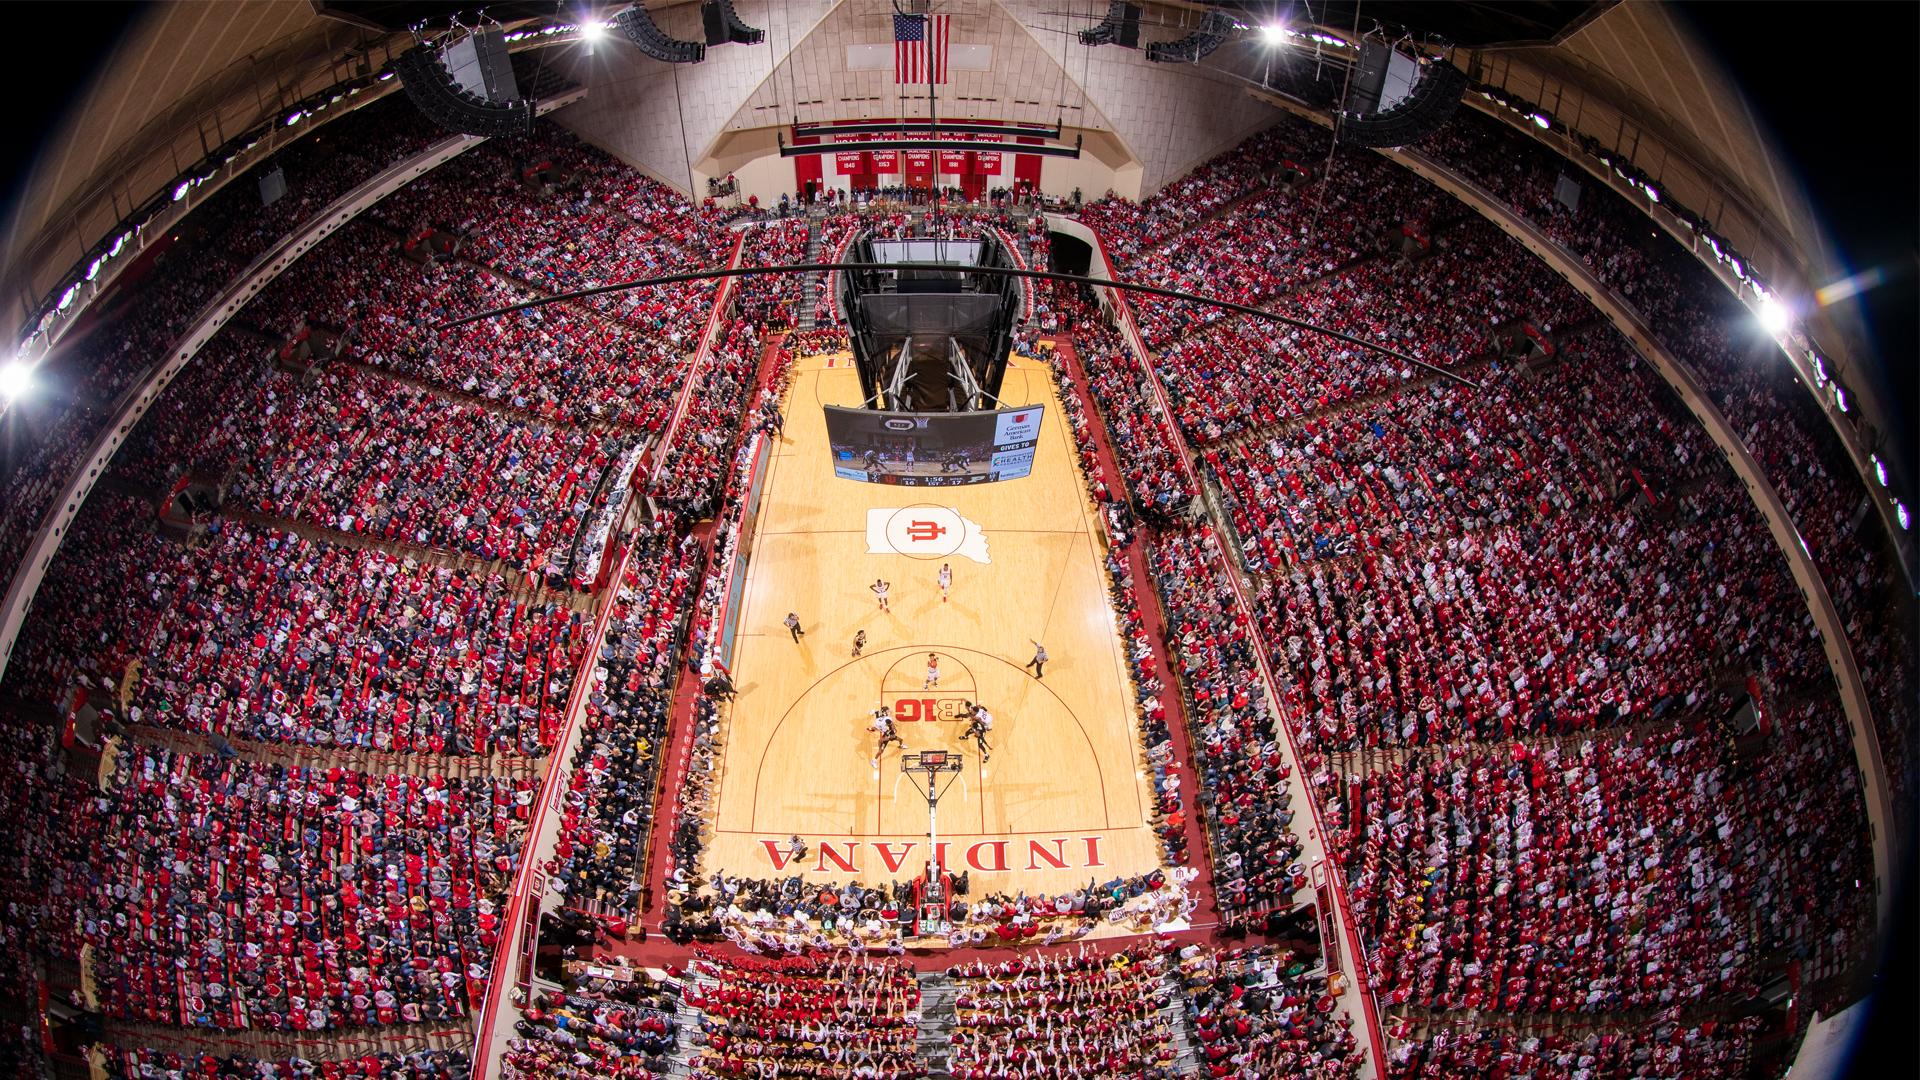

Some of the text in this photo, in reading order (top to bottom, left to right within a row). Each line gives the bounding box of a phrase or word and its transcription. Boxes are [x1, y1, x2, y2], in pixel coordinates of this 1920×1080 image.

[1004, 428, 1031, 436] American
[1000, 443, 1019, 451] GIVES
[1001, 454, 1032, 463] HEALTH
[758, 836, 1105, 875] INDIANA
